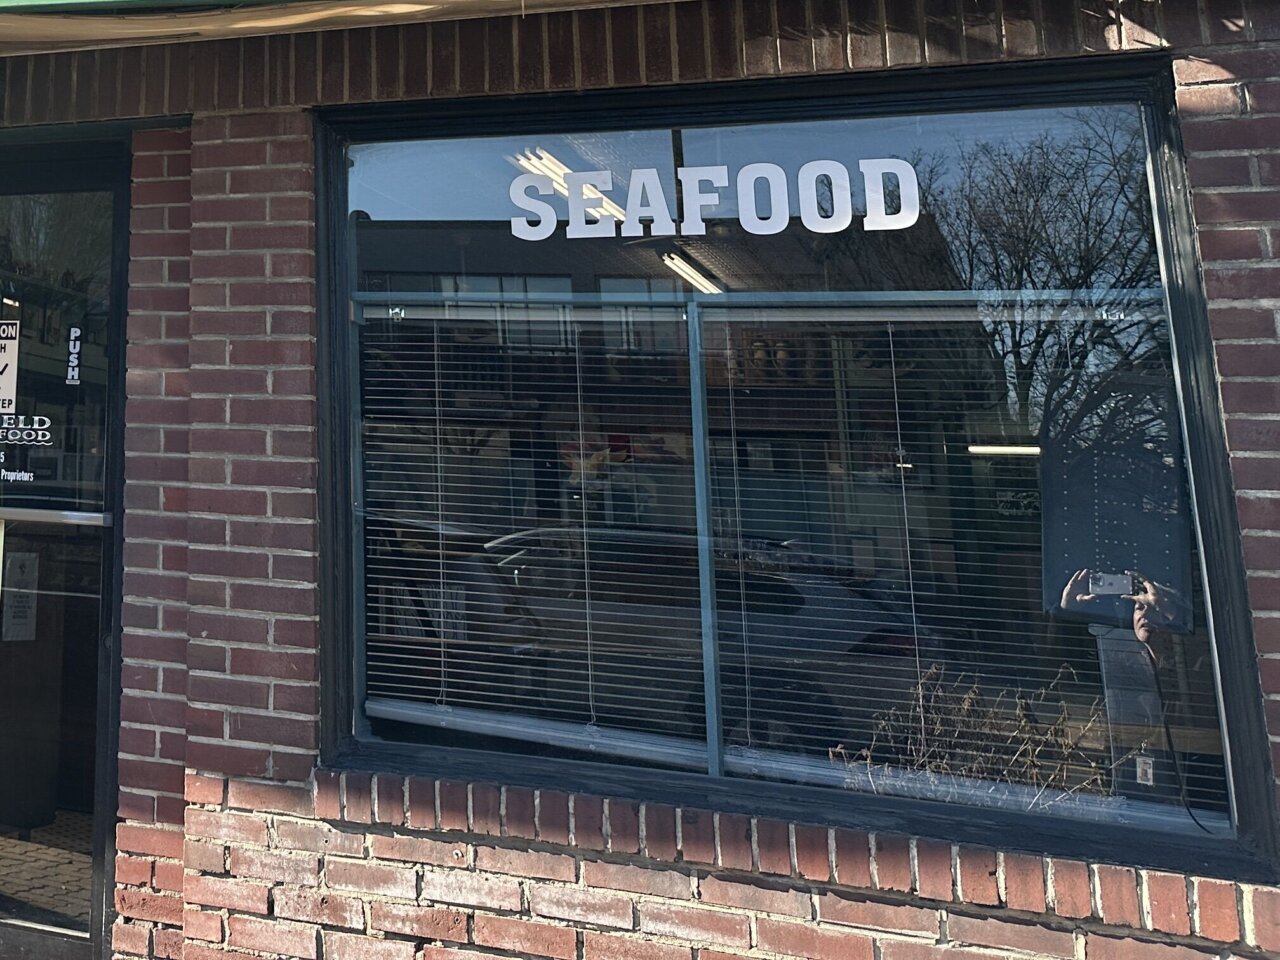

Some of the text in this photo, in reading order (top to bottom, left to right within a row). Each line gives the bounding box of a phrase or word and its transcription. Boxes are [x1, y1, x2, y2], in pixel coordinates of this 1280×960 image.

[509, 159, 921, 241] SEAFOOD
[67, 327, 81, 380] PUSH
[0, 469, 34, 483] Proprietors
